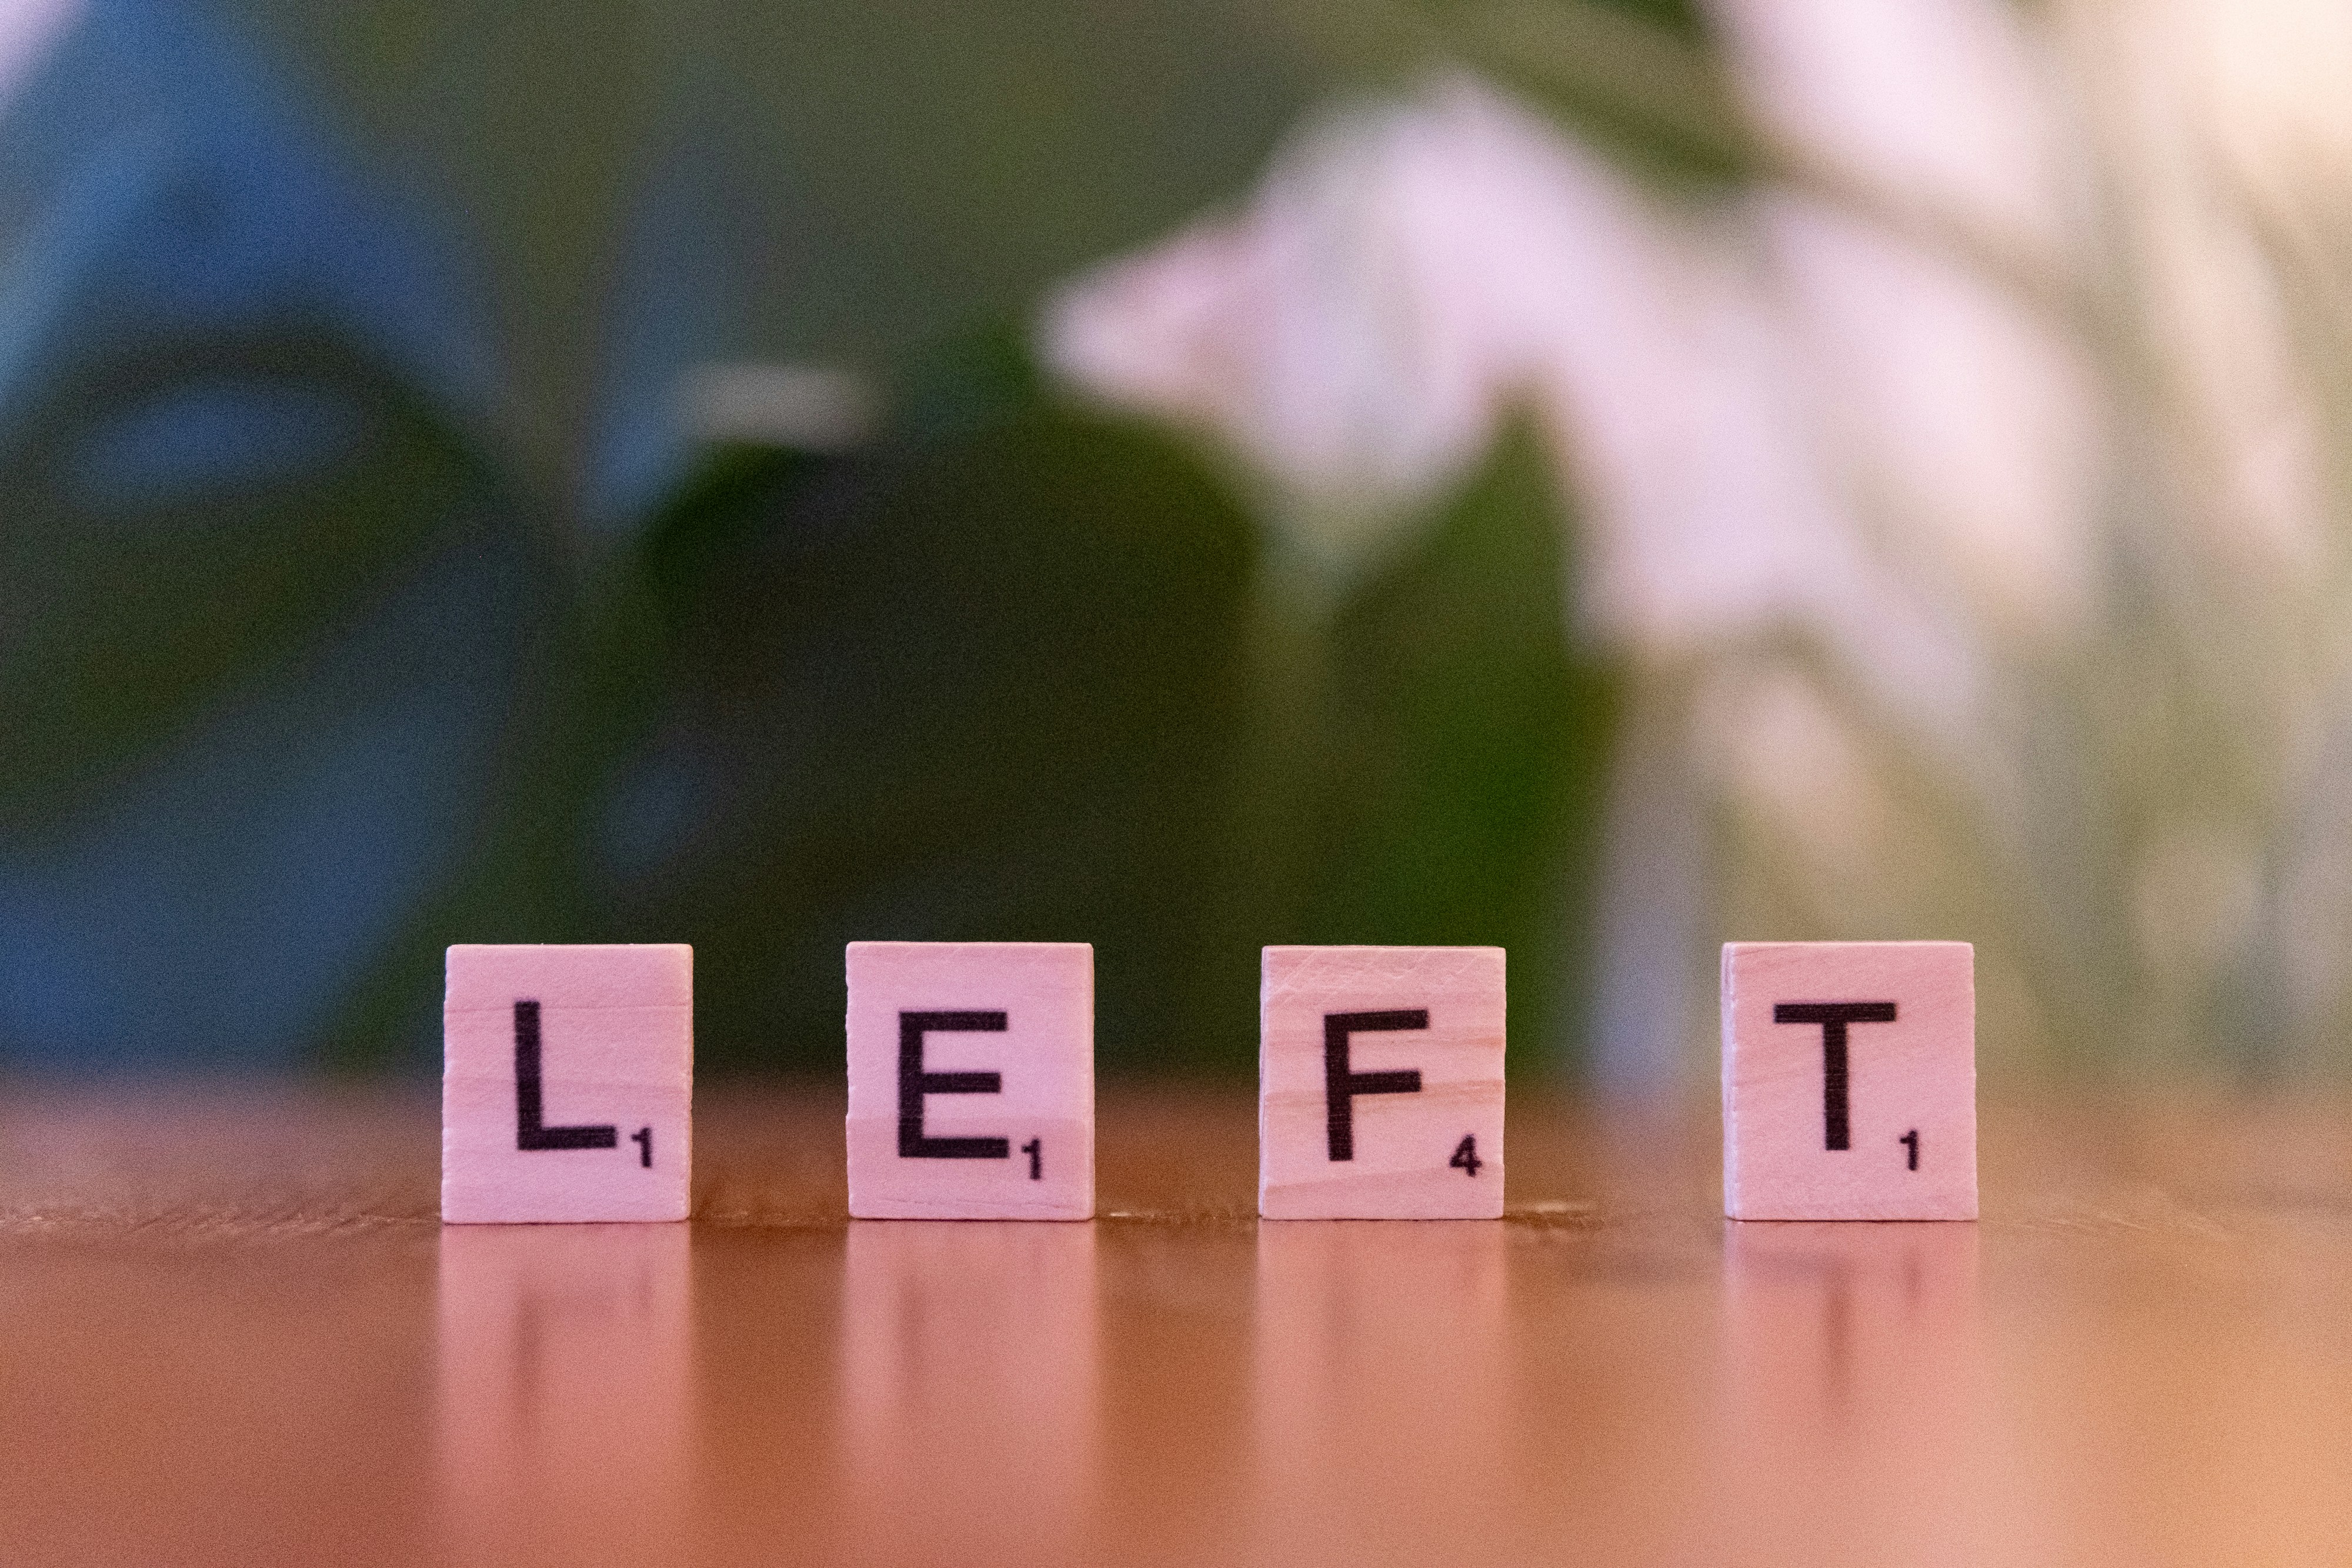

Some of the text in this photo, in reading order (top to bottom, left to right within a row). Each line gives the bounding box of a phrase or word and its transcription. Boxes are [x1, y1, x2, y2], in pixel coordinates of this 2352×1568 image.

[513, 1000, 1897, 1162] L E F T
[630, 1126, 653, 1169] 1
[1020, 1137, 1042, 1181] 1
[1449, 1134, 1483, 1178] 4
[1899, 1129, 1920, 1172] 1
